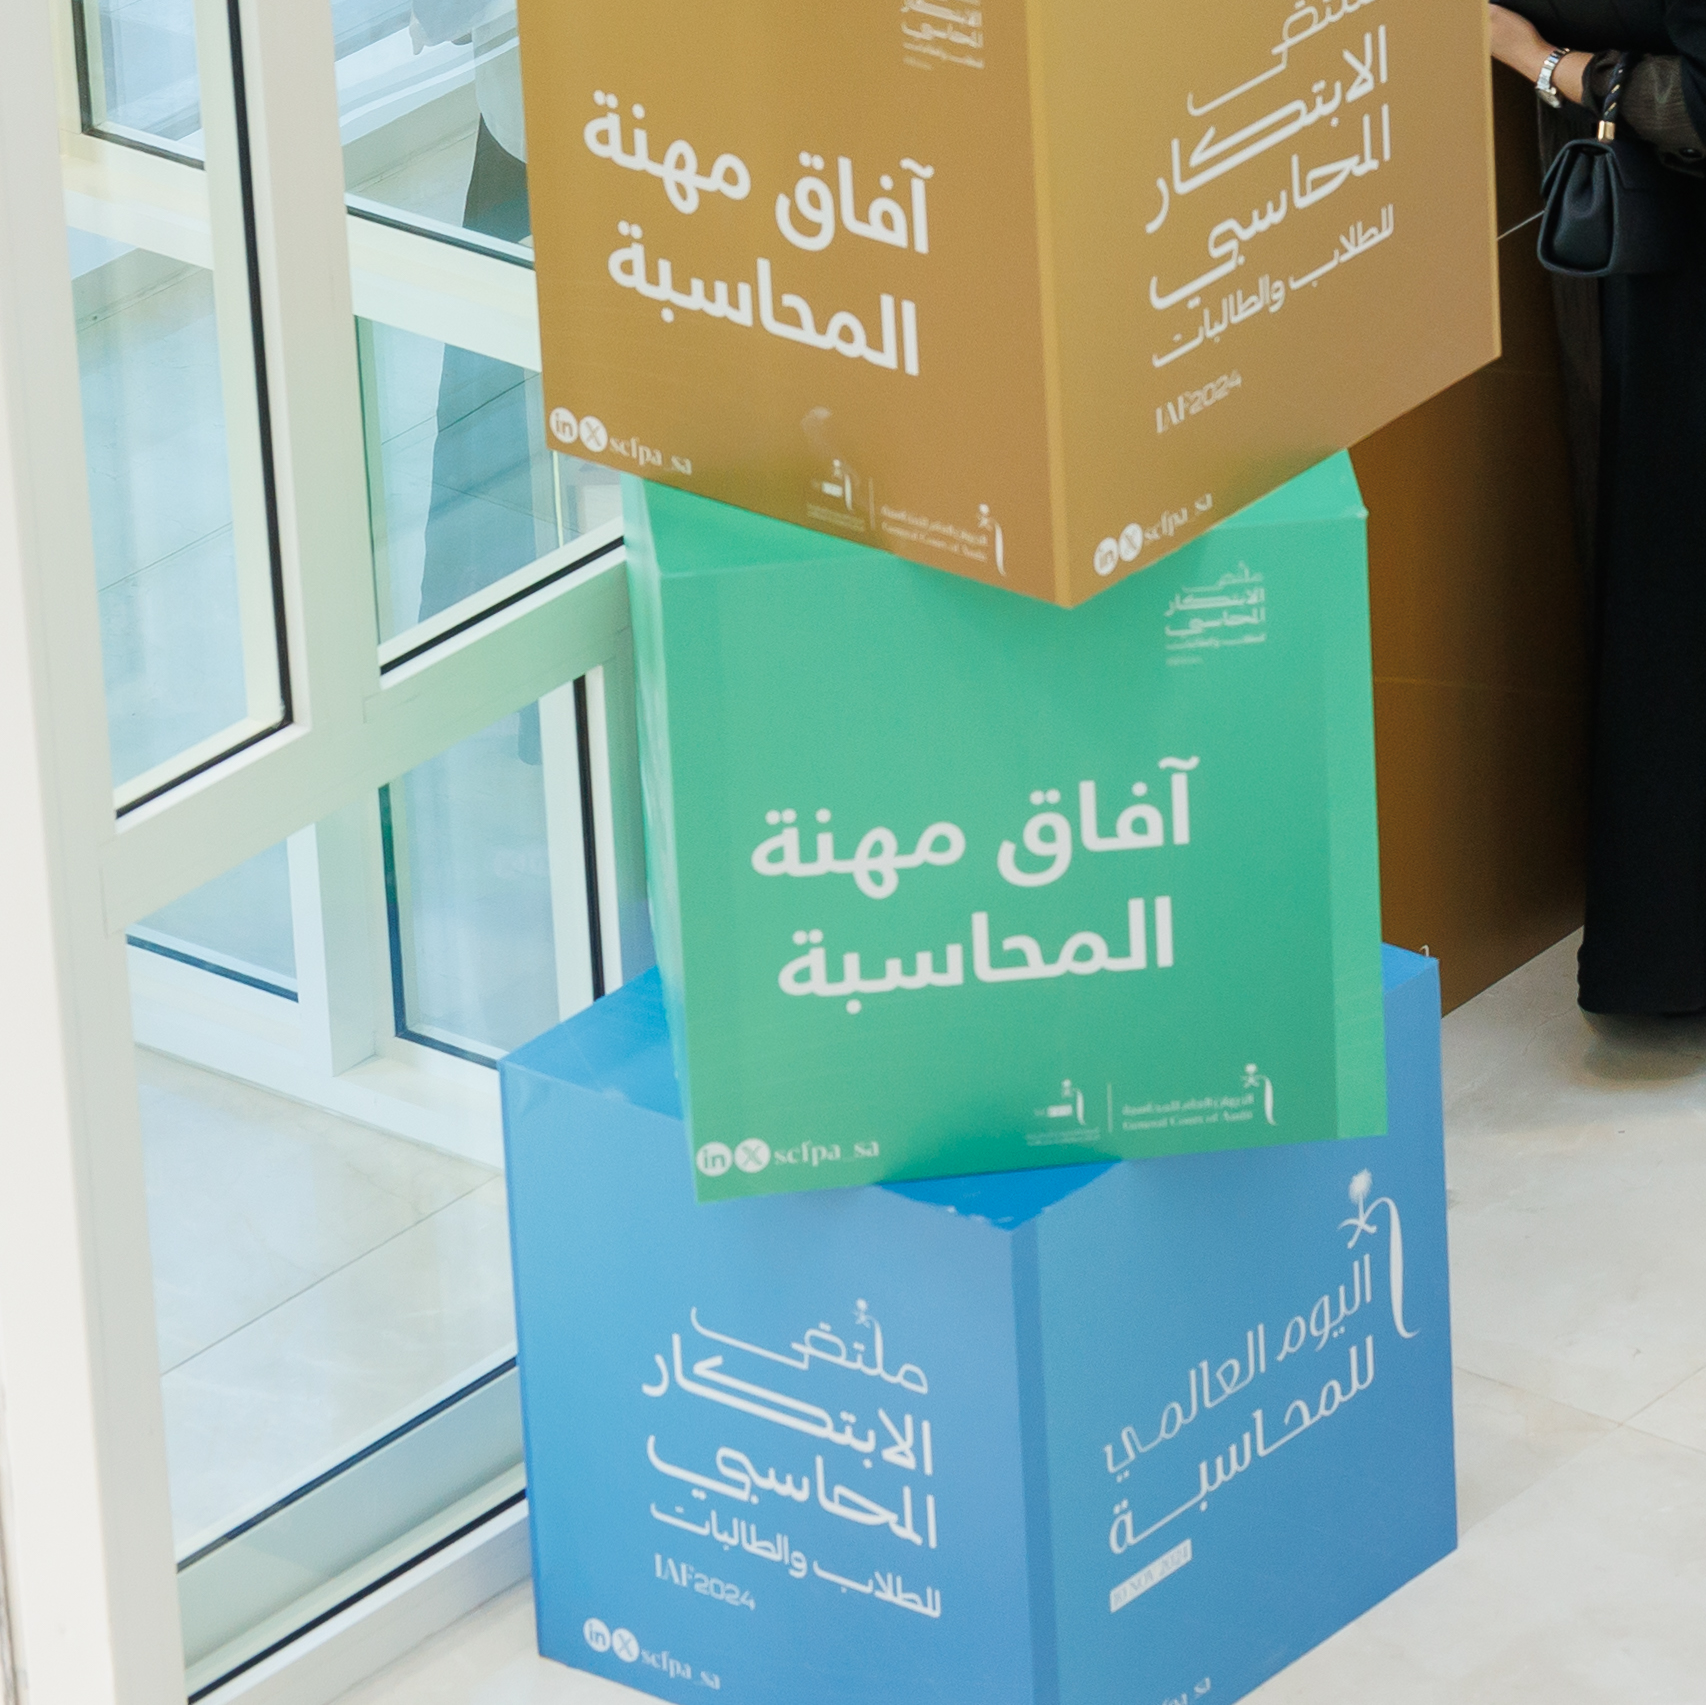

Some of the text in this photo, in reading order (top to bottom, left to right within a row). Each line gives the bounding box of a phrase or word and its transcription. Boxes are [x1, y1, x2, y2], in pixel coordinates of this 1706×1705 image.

[583, 89, 935, 255] آفاق مهنة
[1145, 24, 1388, 234] الابتكار
[1149, 103, 1391, 310] المحاسبي
[607, 220, 919, 377] المحاسبة
[1152, 203, 1395, 368] للطلاب والطالبات
[750, 755, 1201, 900] آفاق مهنة
[777, 895, 1174, 1015] المحاسبة
[641, 1332, 933, 1476] الابتكار
[1103, 1253, 1372, 1483] اليوم العالمي
[1109, 1334, 1374, 1555] للمحاسبة
[647, 1434, 938, 1550] المحاسبي
[650, 1502, 941, 1619] للطلاب والطالبات
